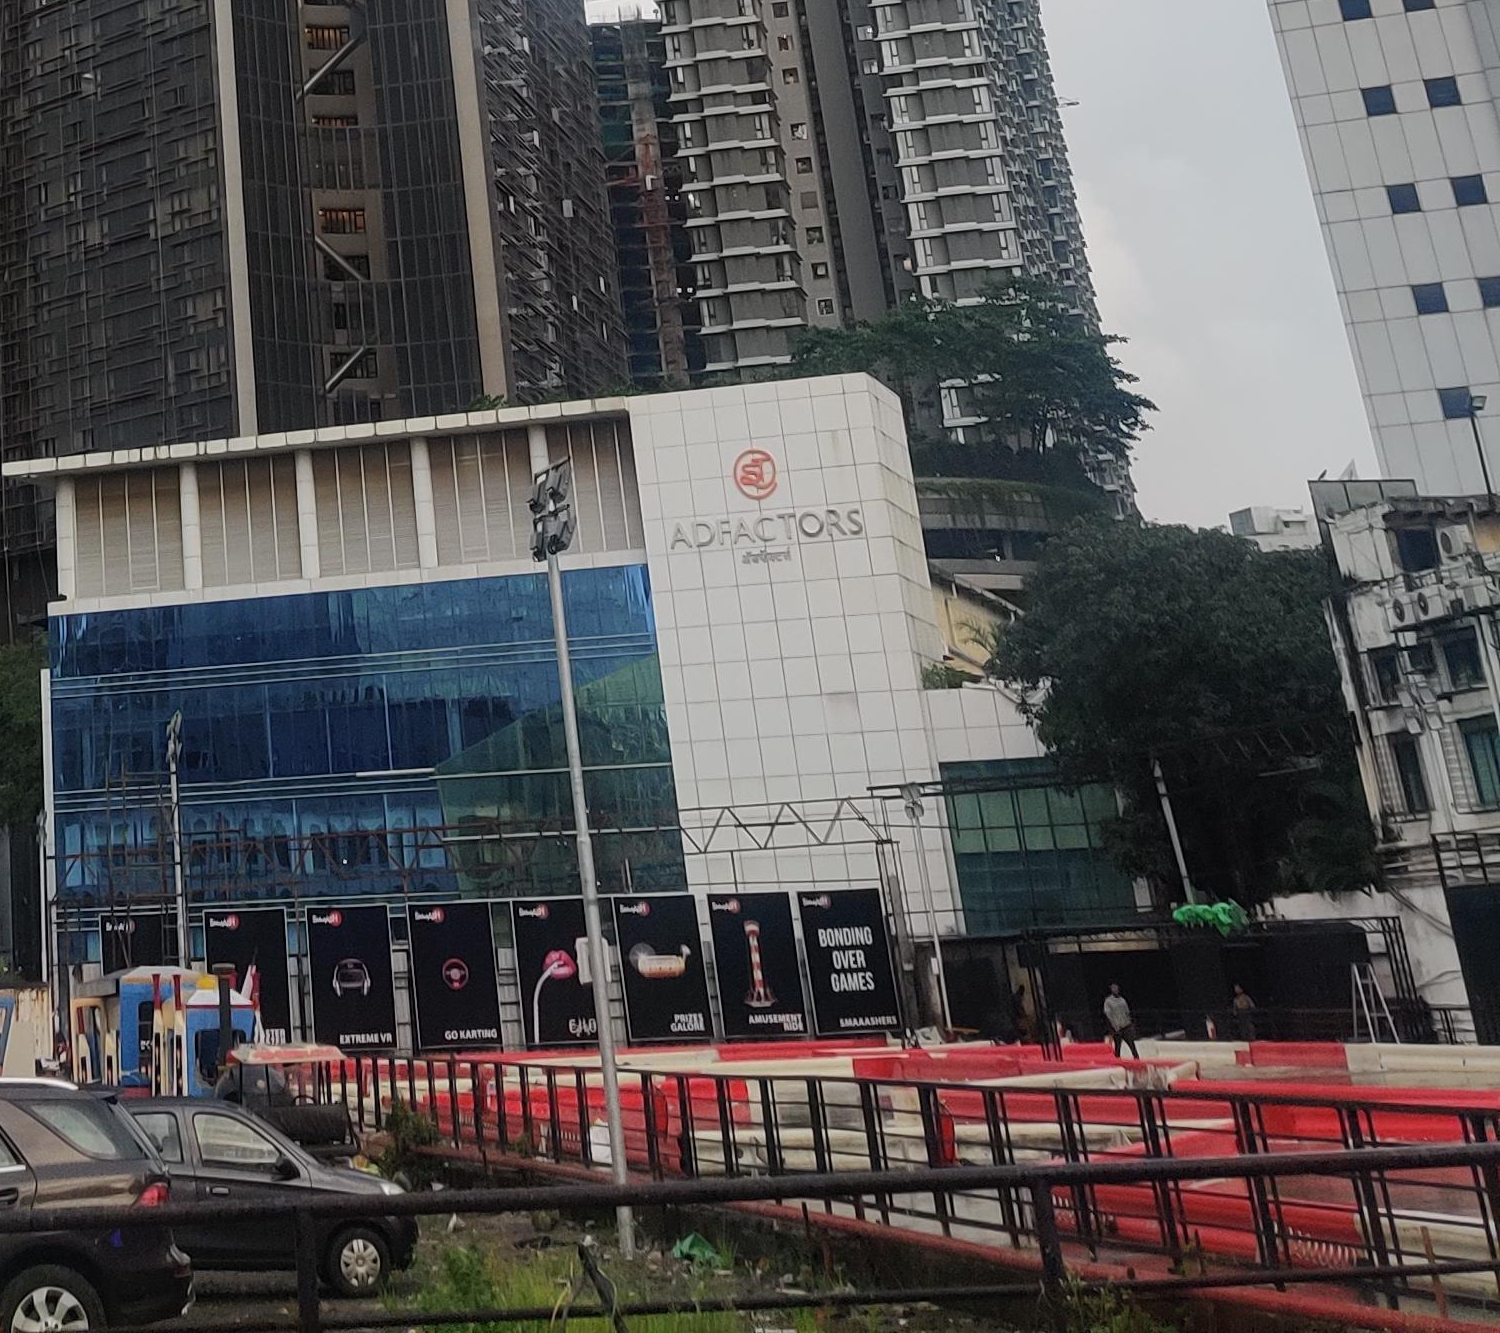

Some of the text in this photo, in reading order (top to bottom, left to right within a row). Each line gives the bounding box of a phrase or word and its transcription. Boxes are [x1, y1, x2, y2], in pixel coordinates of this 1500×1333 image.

[670, 509, 863, 550] ADFACTORS
[817, 926, 874, 947] BONDING
[832, 949, 866, 970] OVER
[830, 971, 875, 992] GAMES
[748, 1013, 802, 1024] AMUSEMENT
[839, 1015, 898, 1027] SMAAASHERS
[340, 1032, 393, 1044] EXTREME VR
[444, 1028, 498, 1040] GO KARTING
